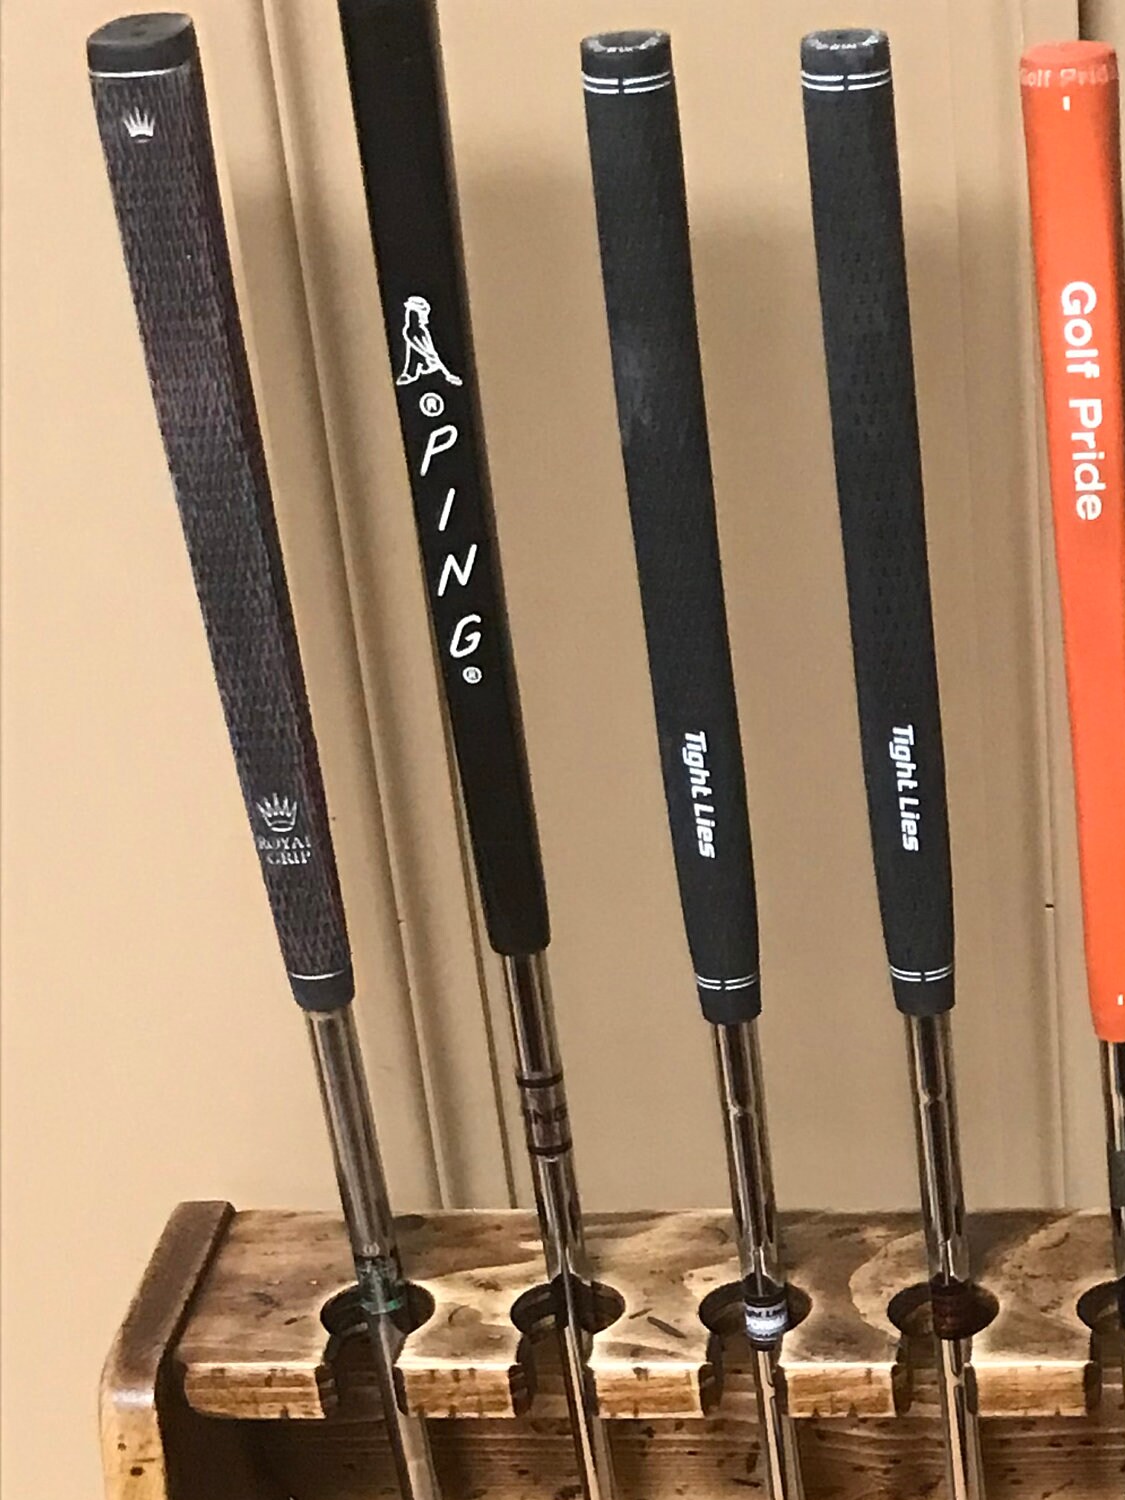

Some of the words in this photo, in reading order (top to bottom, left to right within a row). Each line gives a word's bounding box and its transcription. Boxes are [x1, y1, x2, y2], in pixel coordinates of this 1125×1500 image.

[1061, 281, 1099, 378] Golf
[1069, 399, 1105, 520] Pride
[682, 731, 712, 798] Tight
[889, 725, 917, 791] Tight
[693, 803, 715, 859] Lies
[899, 797, 920, 851] Lies
